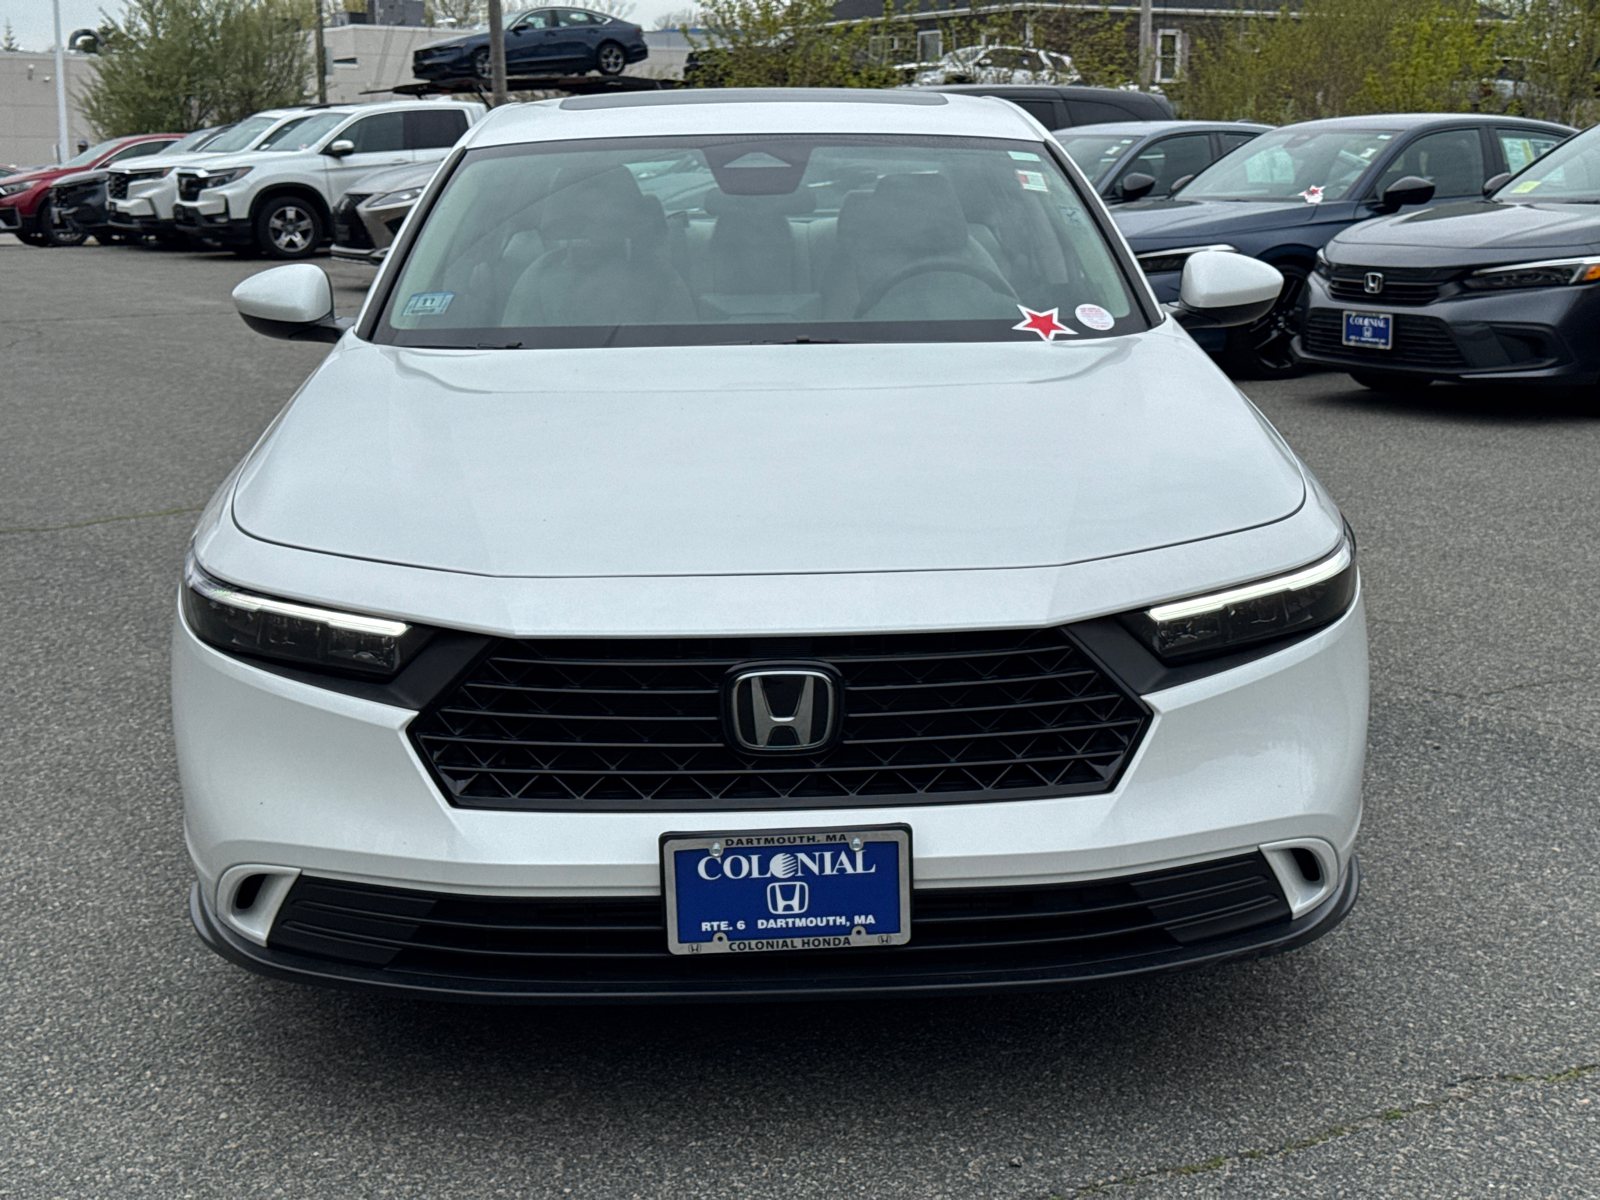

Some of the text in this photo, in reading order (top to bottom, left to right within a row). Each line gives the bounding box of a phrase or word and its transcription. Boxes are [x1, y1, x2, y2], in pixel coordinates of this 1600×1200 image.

[826, 834, 847, 842] MA
[697, 850, 876, 880] COLONIAL
[702, 915, 876, 932] RTE. 6 DARTMOUTH, MA
[729, 937, 851, 951] COLONIAL HONDA
